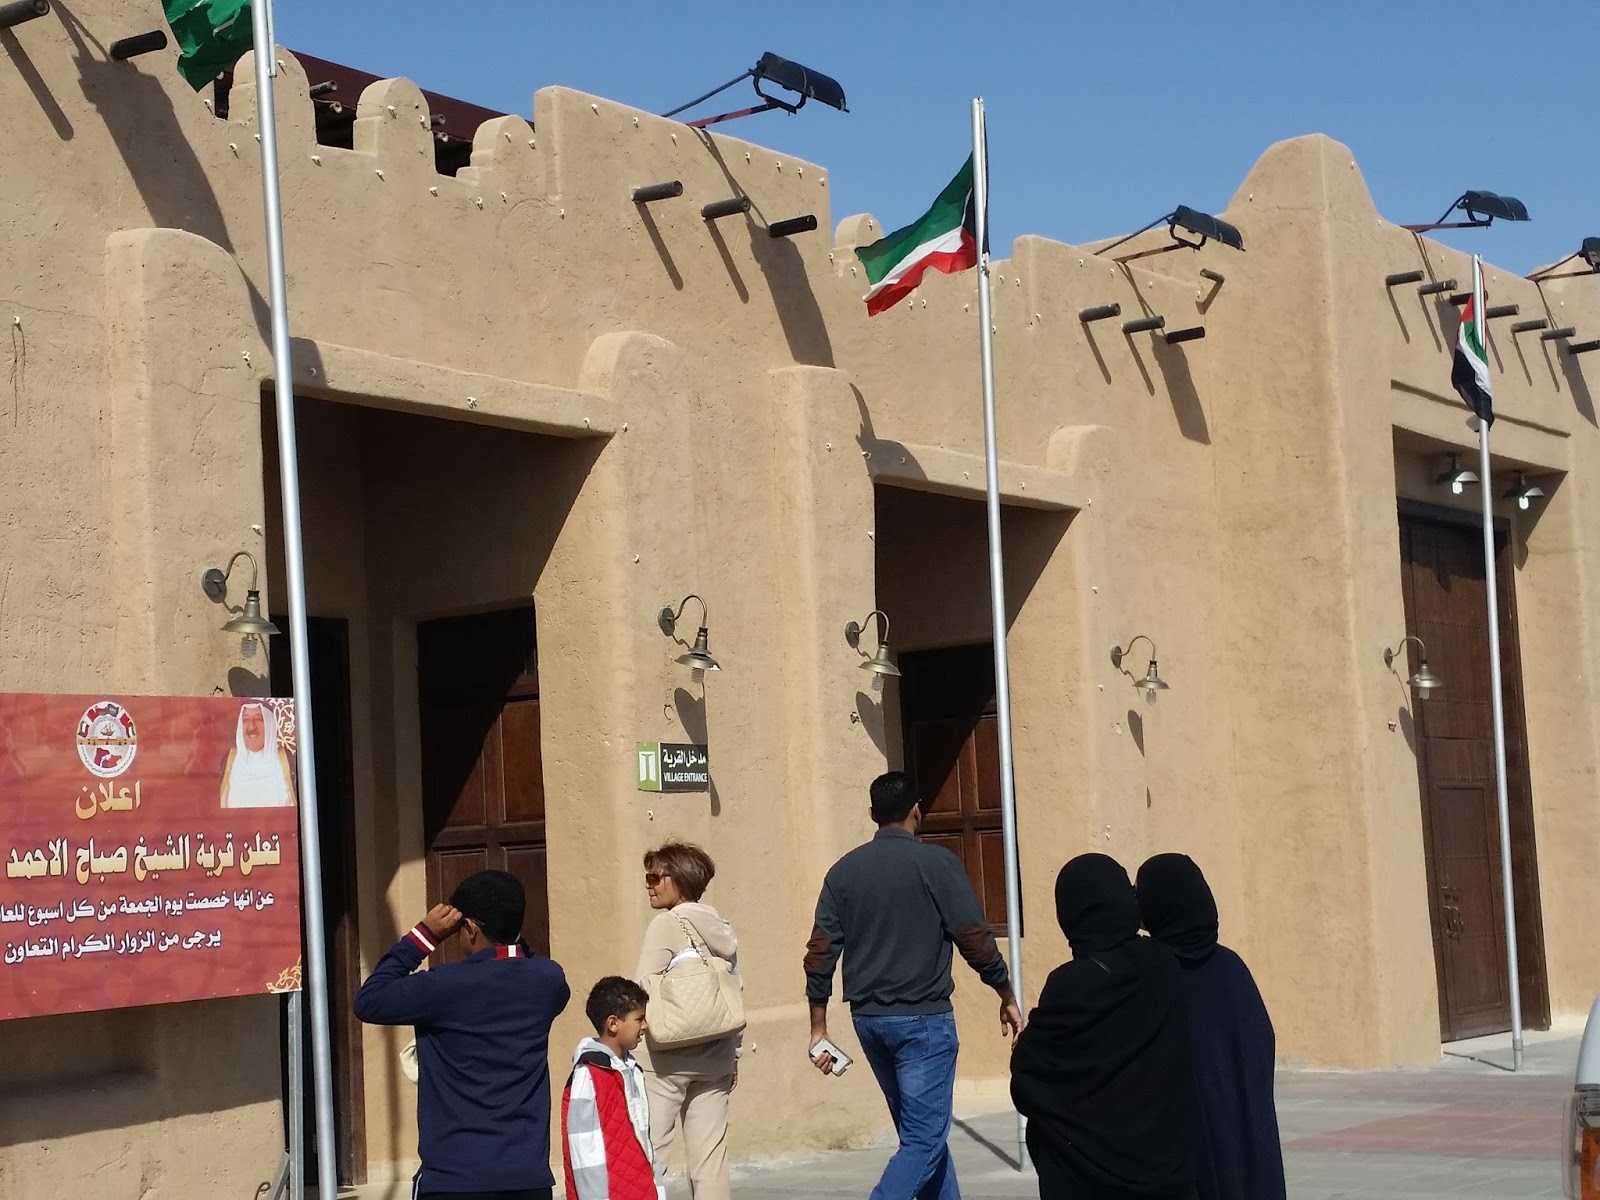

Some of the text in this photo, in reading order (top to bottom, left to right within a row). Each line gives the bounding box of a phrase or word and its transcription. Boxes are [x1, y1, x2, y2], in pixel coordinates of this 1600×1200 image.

[663, 749, 706, 768] مدخل القرية
[663, 772, 708, 783] VILLAGE ENTRANCE
[75, 780, 141, 820] اعلان
[6, 832, 281, 884] تعلن قرية الشيخ صباح الاحمد
[0, 888, 275, 926] عن انها خصصت يوم الجمعة من كل اسبوع للعا
[4, 929, 222, 964] يرجى من الزوار الكرام التعاون
